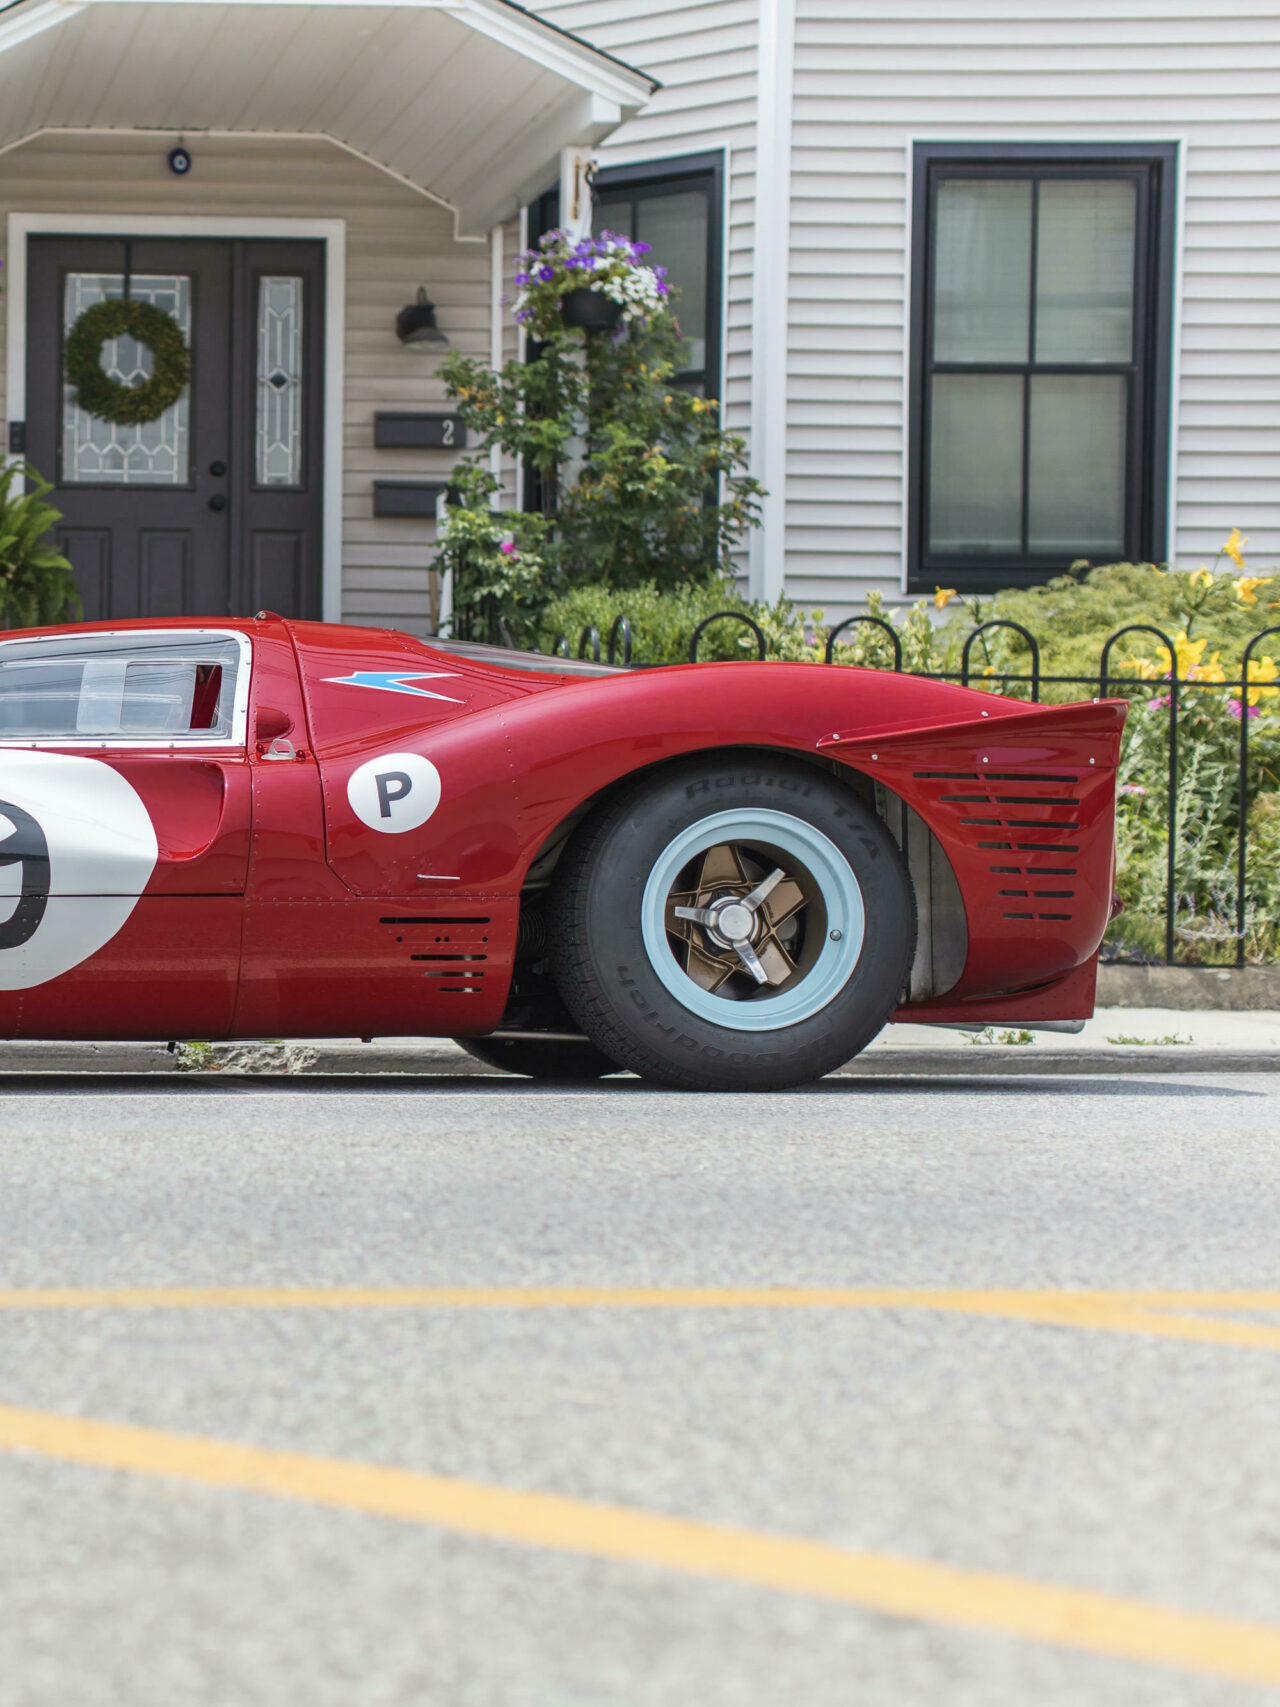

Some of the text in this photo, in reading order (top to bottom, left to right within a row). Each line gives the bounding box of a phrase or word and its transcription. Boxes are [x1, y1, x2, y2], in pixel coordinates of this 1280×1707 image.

[442, 419, 455, 446] 2
[374, 771, 413, 818] P
[684, 773, 880, 861] Radial T/A
